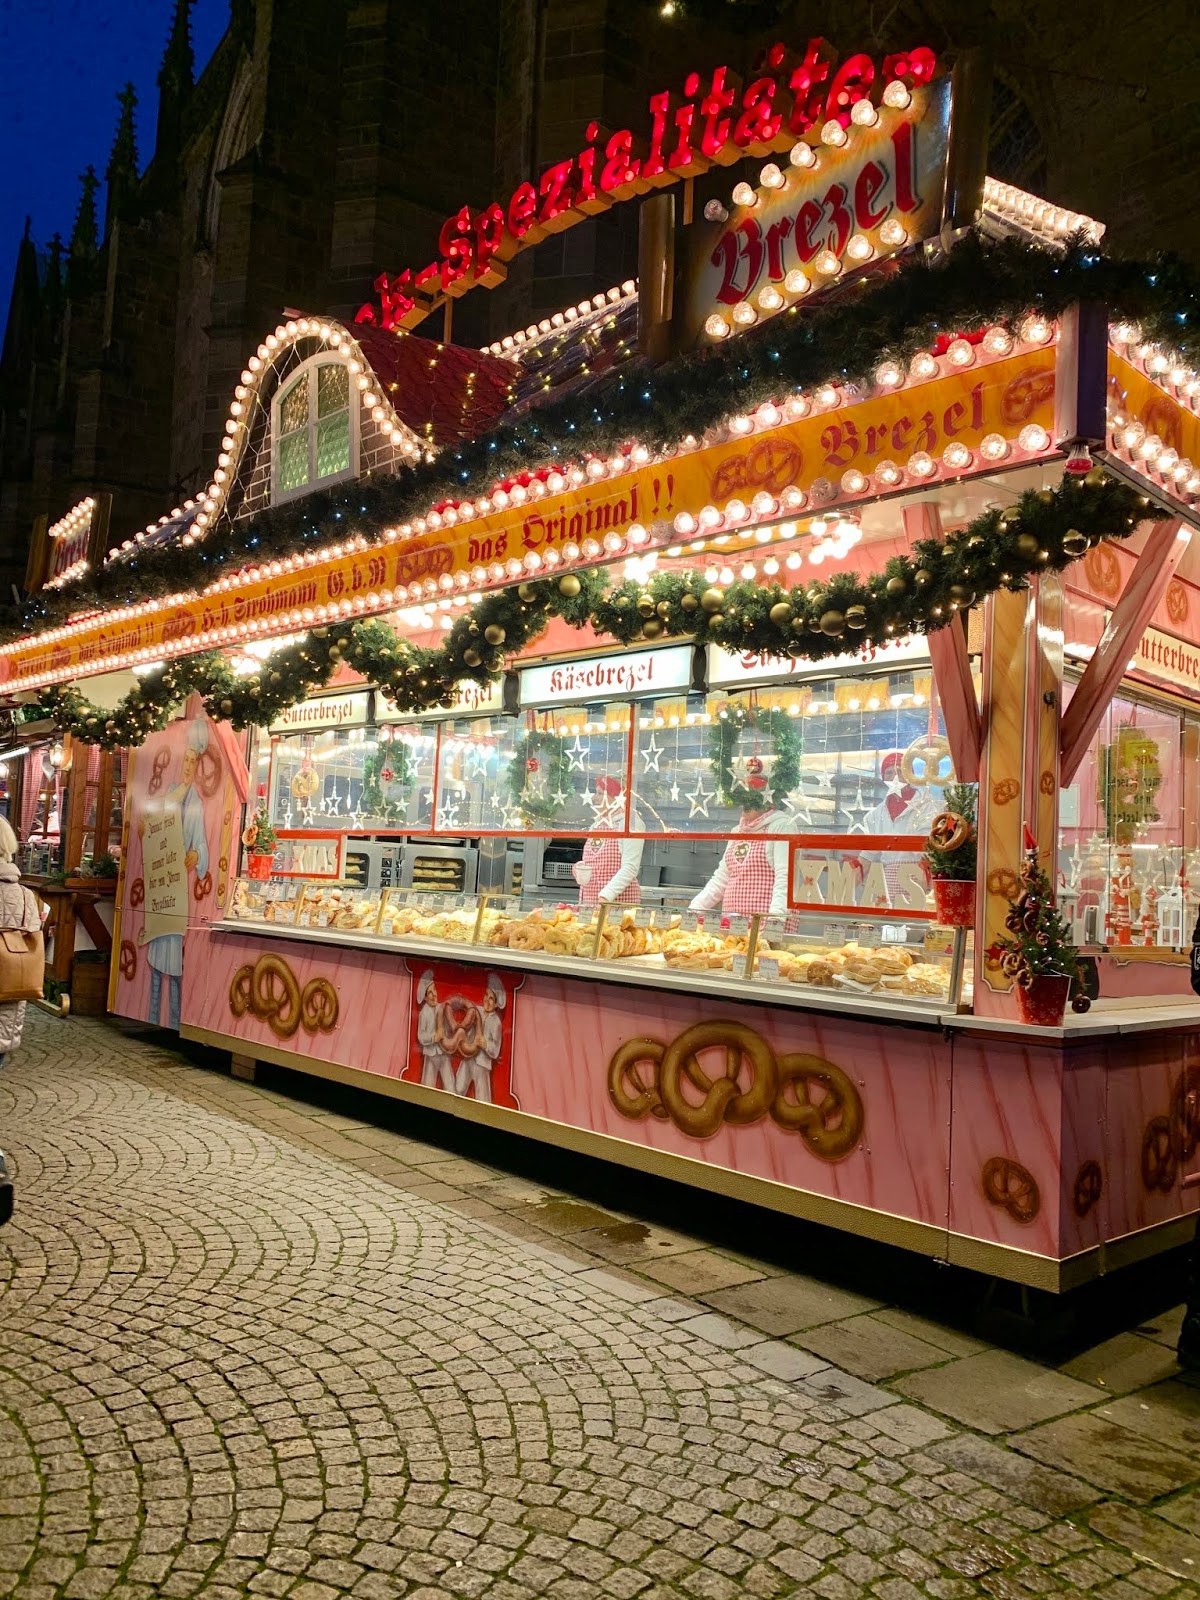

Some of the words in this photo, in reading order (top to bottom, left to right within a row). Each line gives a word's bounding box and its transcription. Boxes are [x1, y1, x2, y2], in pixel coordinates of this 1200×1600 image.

[711, 122, 919, 305] Brezel
[820, 381, 985, 467] Brezel
[467, 526, 508, 564] das
[520, 482, 640, 544] Original
[550, 656, 654, 692] Käsebrezel
[1134, 635, 1200, 679] utterbre
[281, 700, 353, 724] Butterbrezel
[800, 859, 927, 912] XMAS
